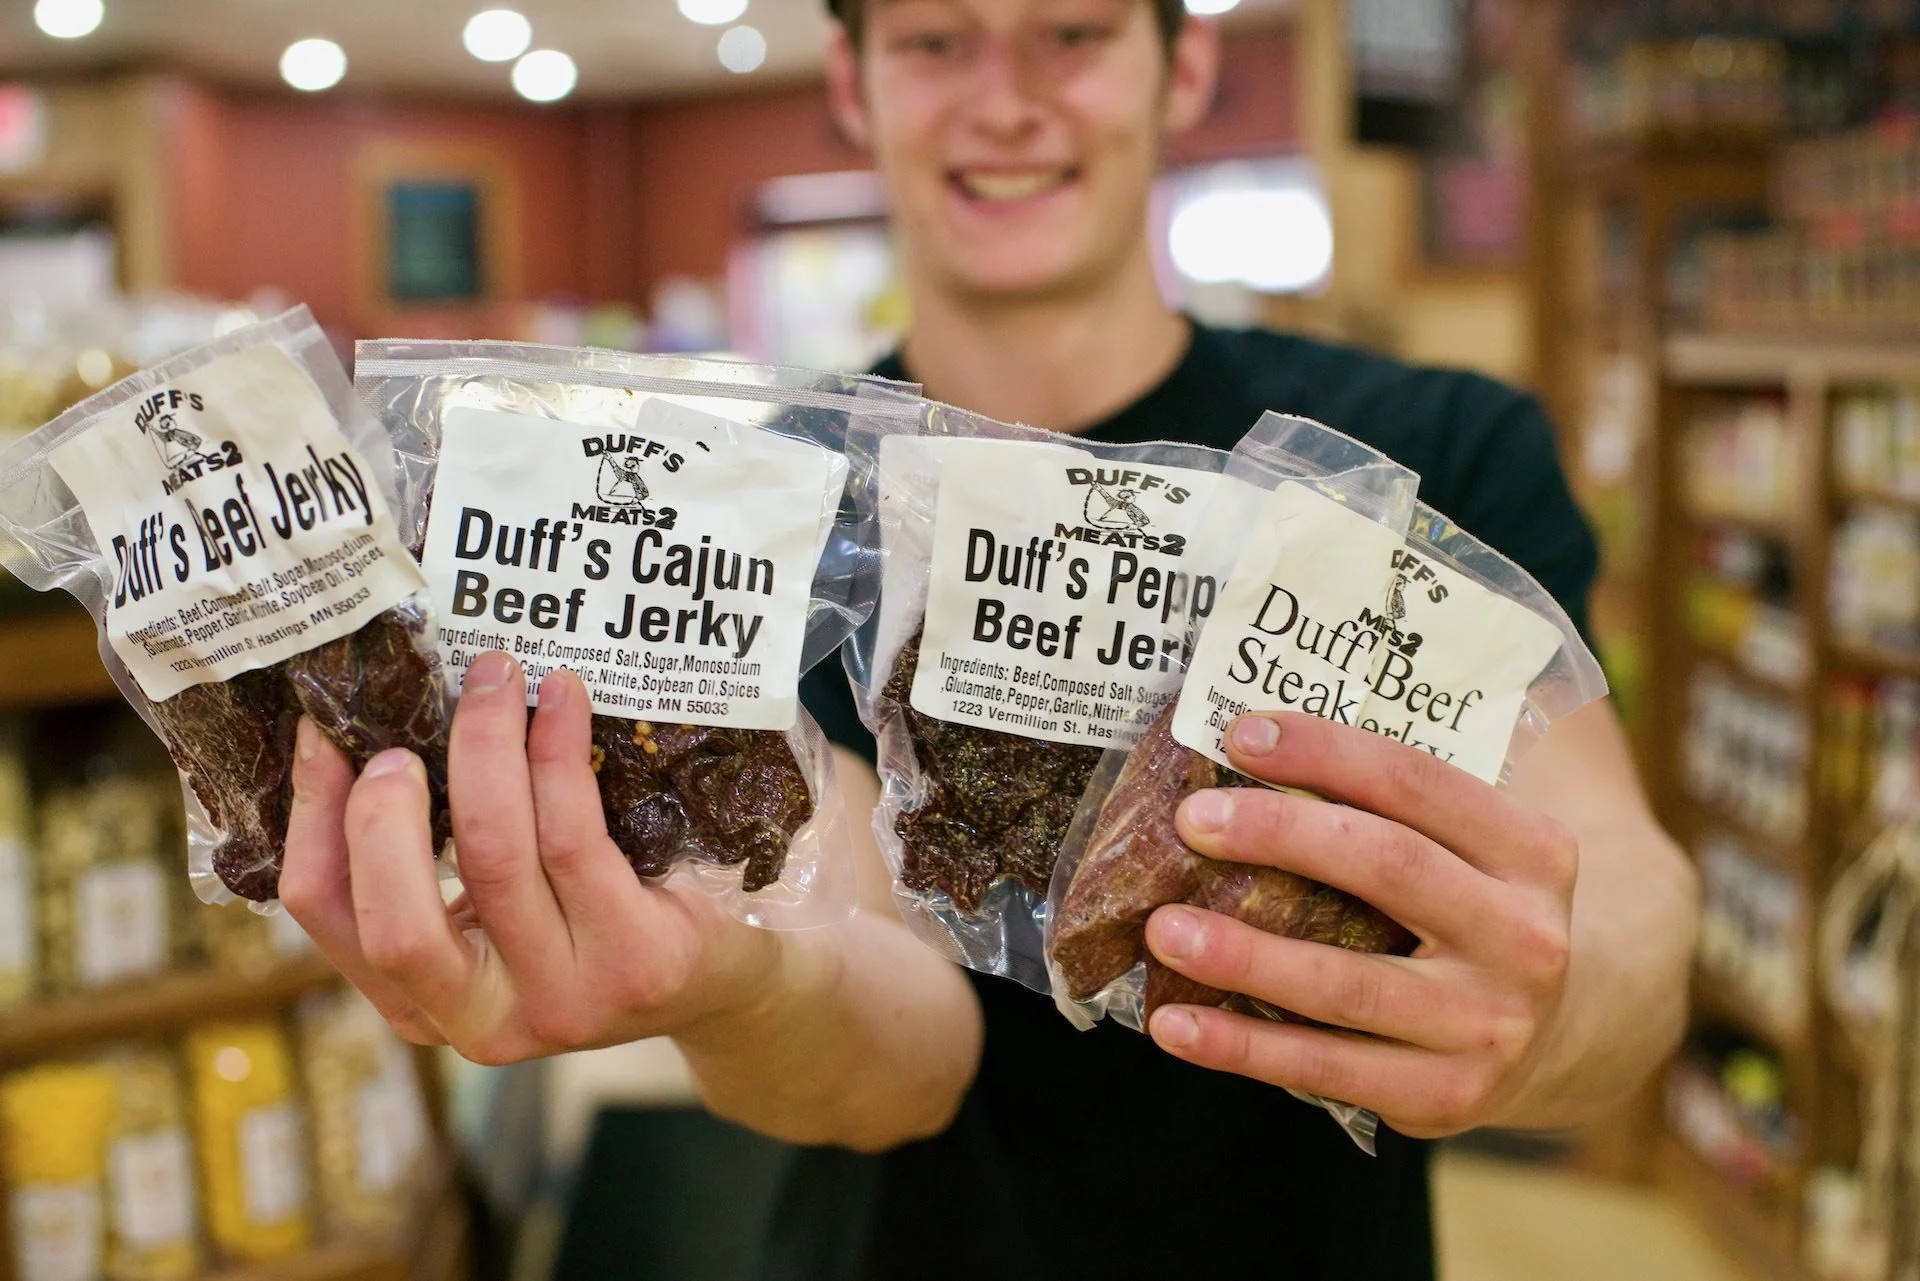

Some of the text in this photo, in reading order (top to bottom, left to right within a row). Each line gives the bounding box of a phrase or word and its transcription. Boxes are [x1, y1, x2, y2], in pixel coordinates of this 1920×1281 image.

[134, 389, 204, 434] DUFF'S
[162, 441, 243, 496] MEATS2
[581, 433, 686, 473] DUFF'S
[1065, 468, 1191, 505] DUFF'S
[112, 512, 189, 609] Duff's
[263, 444, 374, 540] Jerky
[571, 502, 678, 531] MEATS2
[454, 505, 775, 600] Duff's Cajun
[1054, 523, 1187, 556] MEATS2
[965, 528, 1228, 624] Duff's Pepp
[126, 615, 179, 645] Ingredients:
[258, 620, 310, 647] Hastings
[309, 607, 334, 626] MN
[333, 587, 372, 616] 55033
[451, 569, 764, 659] Beef Jerky
[972, 598, 1083, 660] Beef
[437, 625, 511, 652] ngredients:
[940, 652, 1009, 680] Ingredients:
[1228, 636, 1360, 726] Steak
[592, 689, 729, 715] Hastings MN 55033
[1207, 685, 1252, 716] Ingredi
[1371, 648, 1483, 733] Beef
[953, 700, 983, 716] 1223
[989, 706, 1057, 731] Vermillion
[1063, 720, 1081, 734] St.
